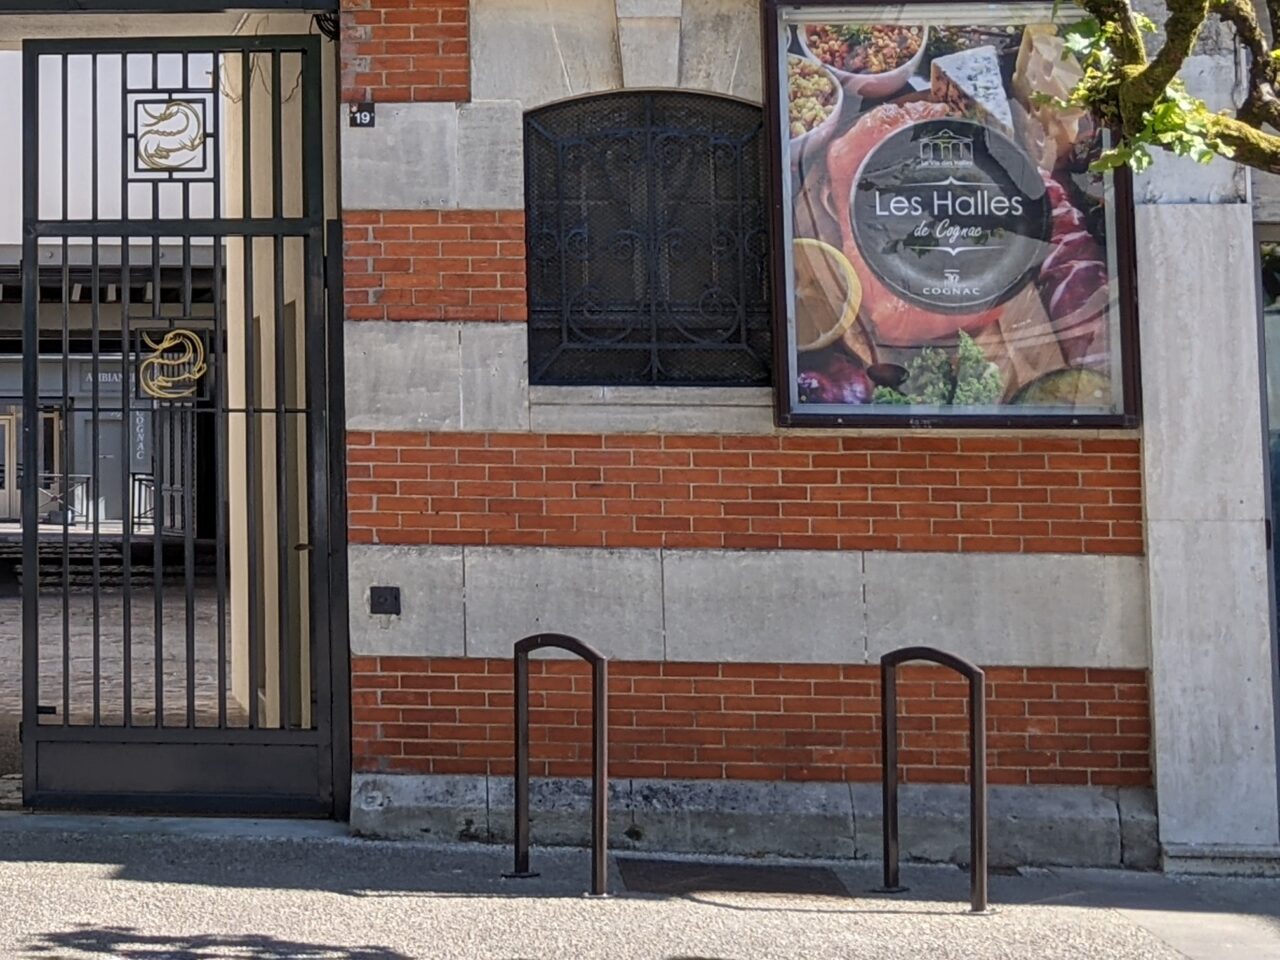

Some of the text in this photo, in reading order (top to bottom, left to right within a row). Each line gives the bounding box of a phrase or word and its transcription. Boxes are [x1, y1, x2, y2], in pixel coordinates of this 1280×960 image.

[354, 111, 371, 124] 19
[875, 190, 1024, 216] Les Halles
[914, 218, 983, 244] de Cognac
[922, 287, 981, 296] COGNAC
